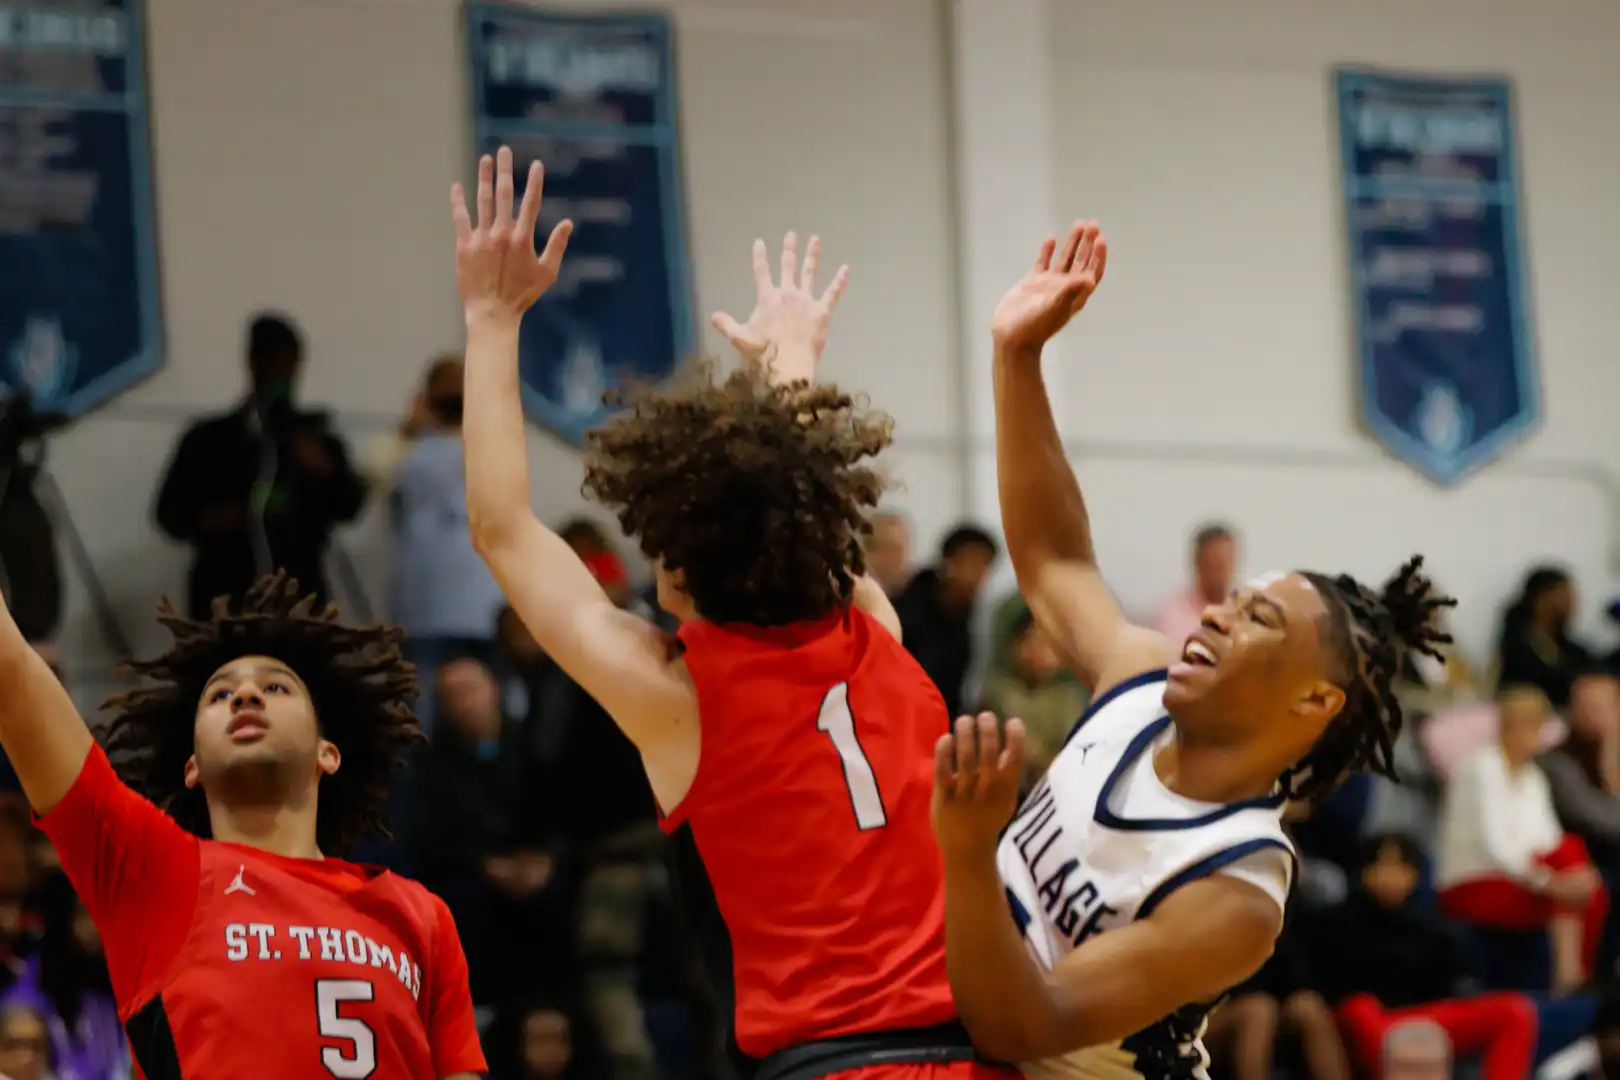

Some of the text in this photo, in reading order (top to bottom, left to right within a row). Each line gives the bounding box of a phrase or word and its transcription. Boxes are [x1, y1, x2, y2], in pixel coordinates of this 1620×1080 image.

[817, 680, 888, 831] 1
[225, 923, 422, 1001] ST. THOMAS
[315, 979, 377, 1080] 5
